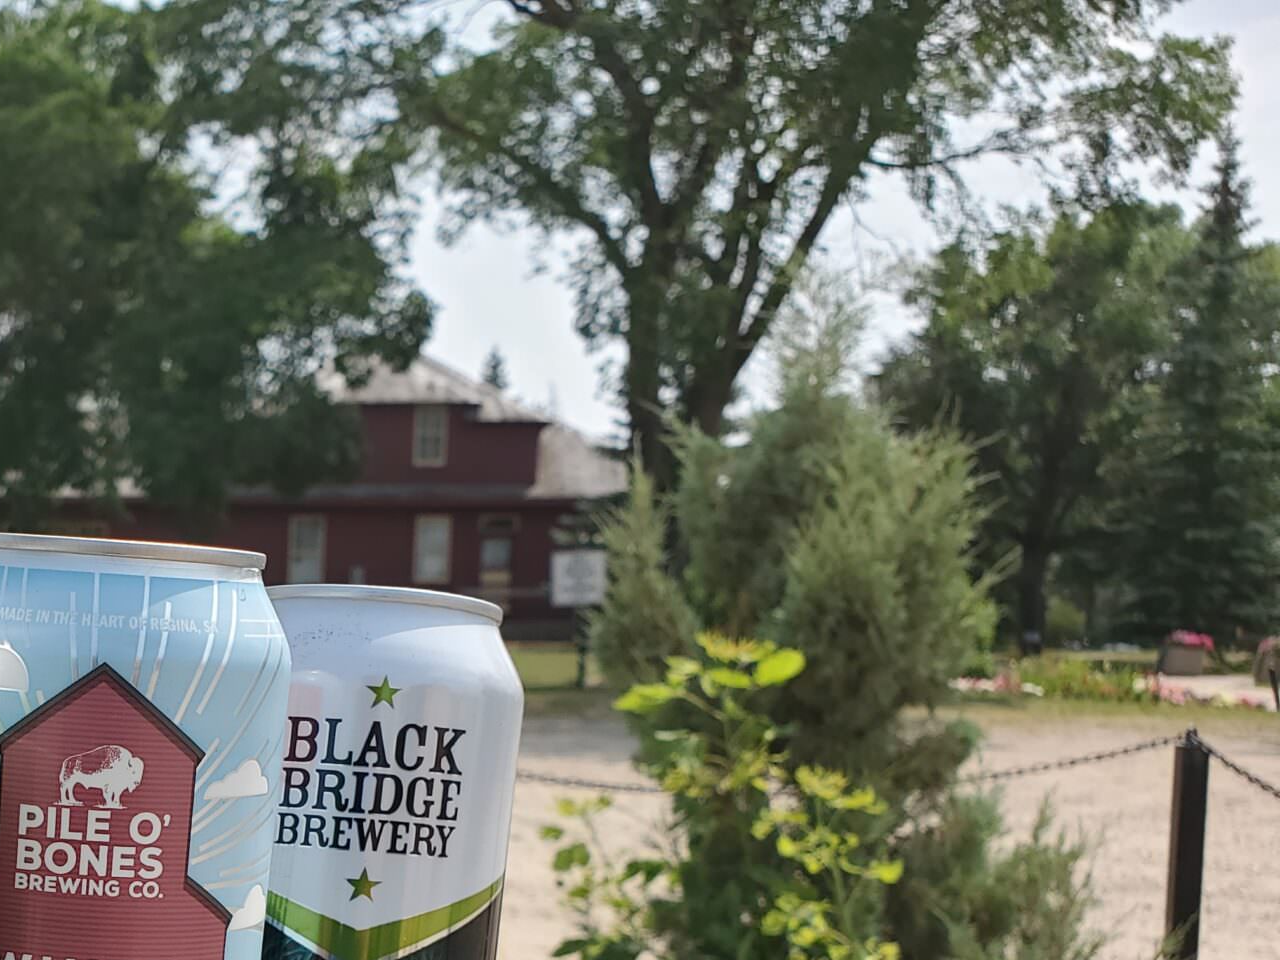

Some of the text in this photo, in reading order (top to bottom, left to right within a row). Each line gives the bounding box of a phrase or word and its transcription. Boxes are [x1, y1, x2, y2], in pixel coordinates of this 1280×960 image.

[35, 609, 50, 624] IN
[53, 611, 78, 625] THE
[81, 612, 125, 629] HEART
[128, 616, 148, 631] OF
[151, 617, 201, 634] REGINA,
[283, 715, 466, 776] BLACK
[278, 767, 462, 822] BRIDGE
[18, 804, 171, 845] PILE O'
[273, 812, 456, 858] BREWERY
[15, 838, 164, 880] BONES
[14, 872, 164, 899] BREWING CO.
